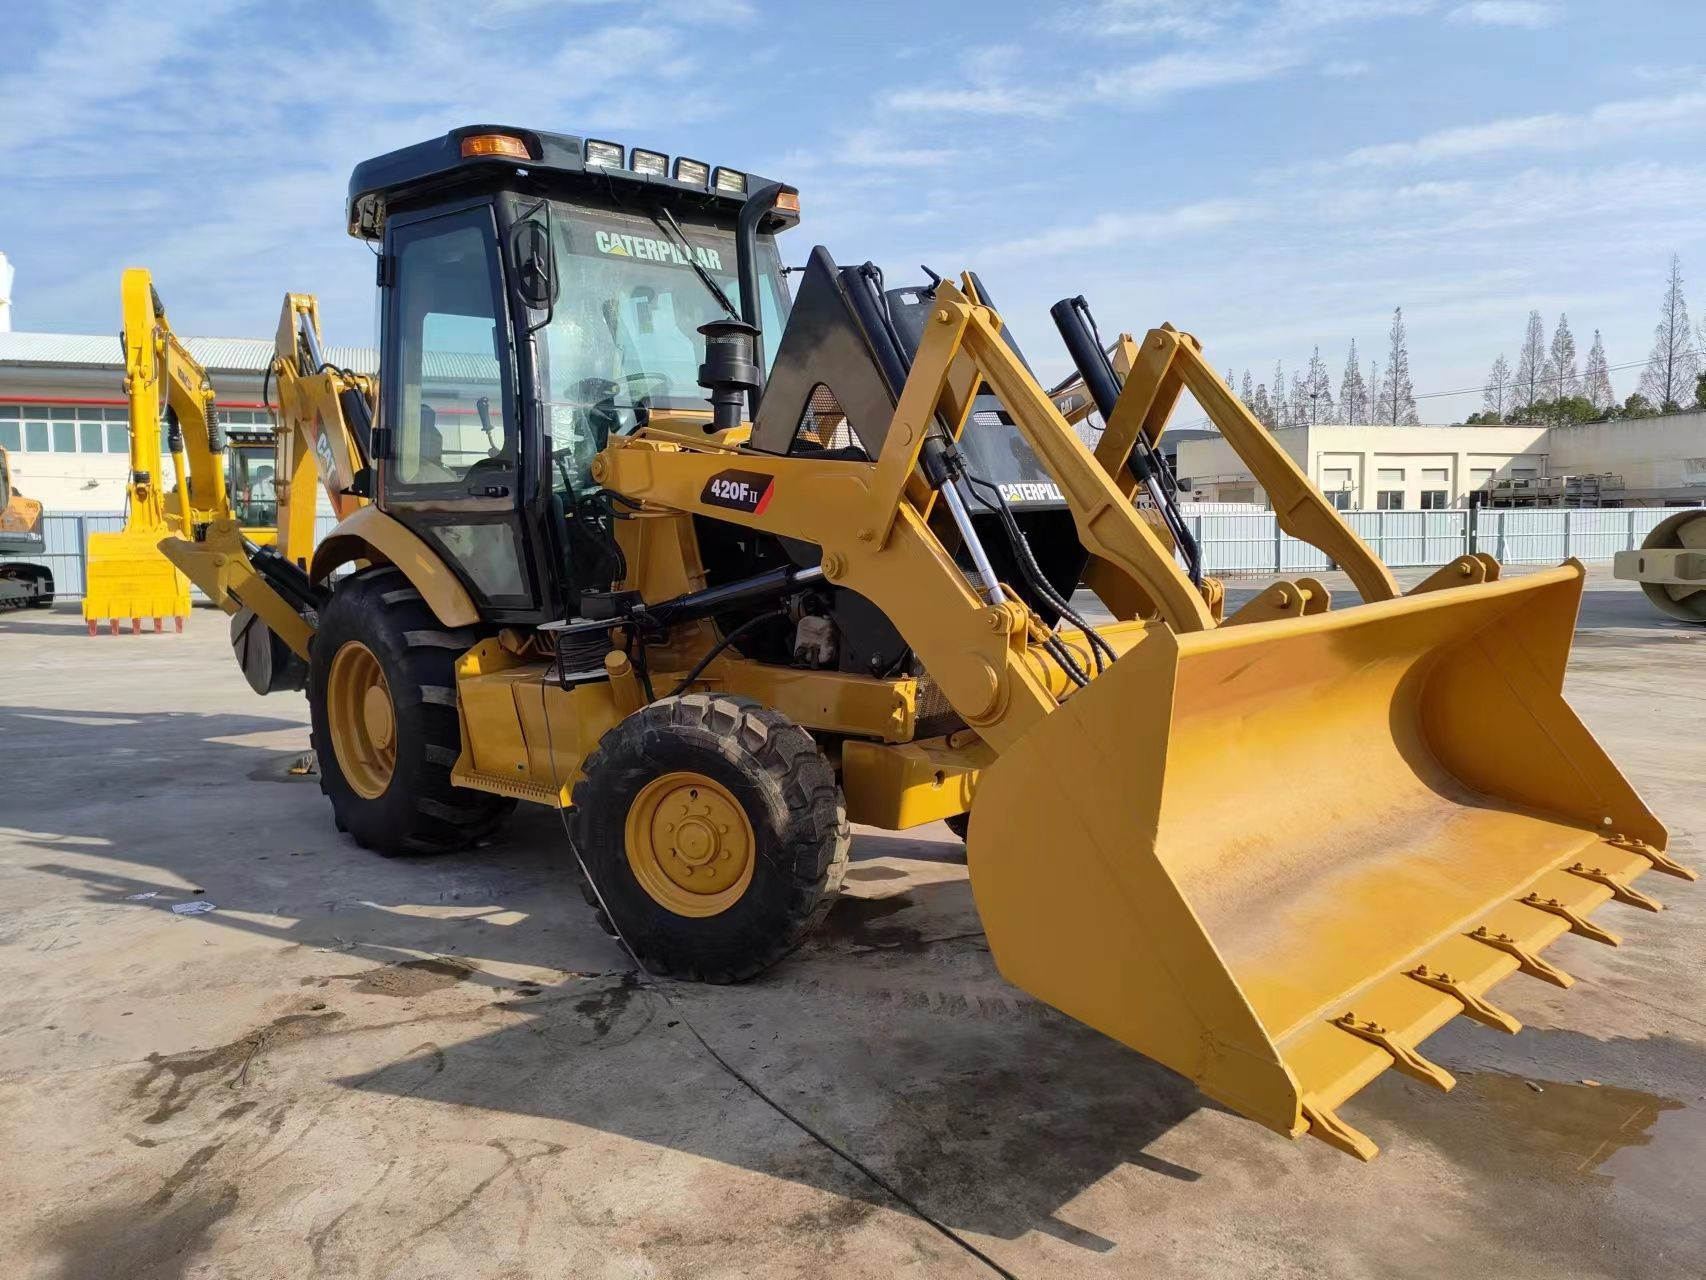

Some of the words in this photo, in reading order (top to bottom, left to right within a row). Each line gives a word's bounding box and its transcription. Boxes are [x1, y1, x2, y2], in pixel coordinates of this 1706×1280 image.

[595, 230, 723, 270] CATERPILLAR
[316, 432, 337, 481] CAT
[998, 483, 1066, 502] CATERPILL
